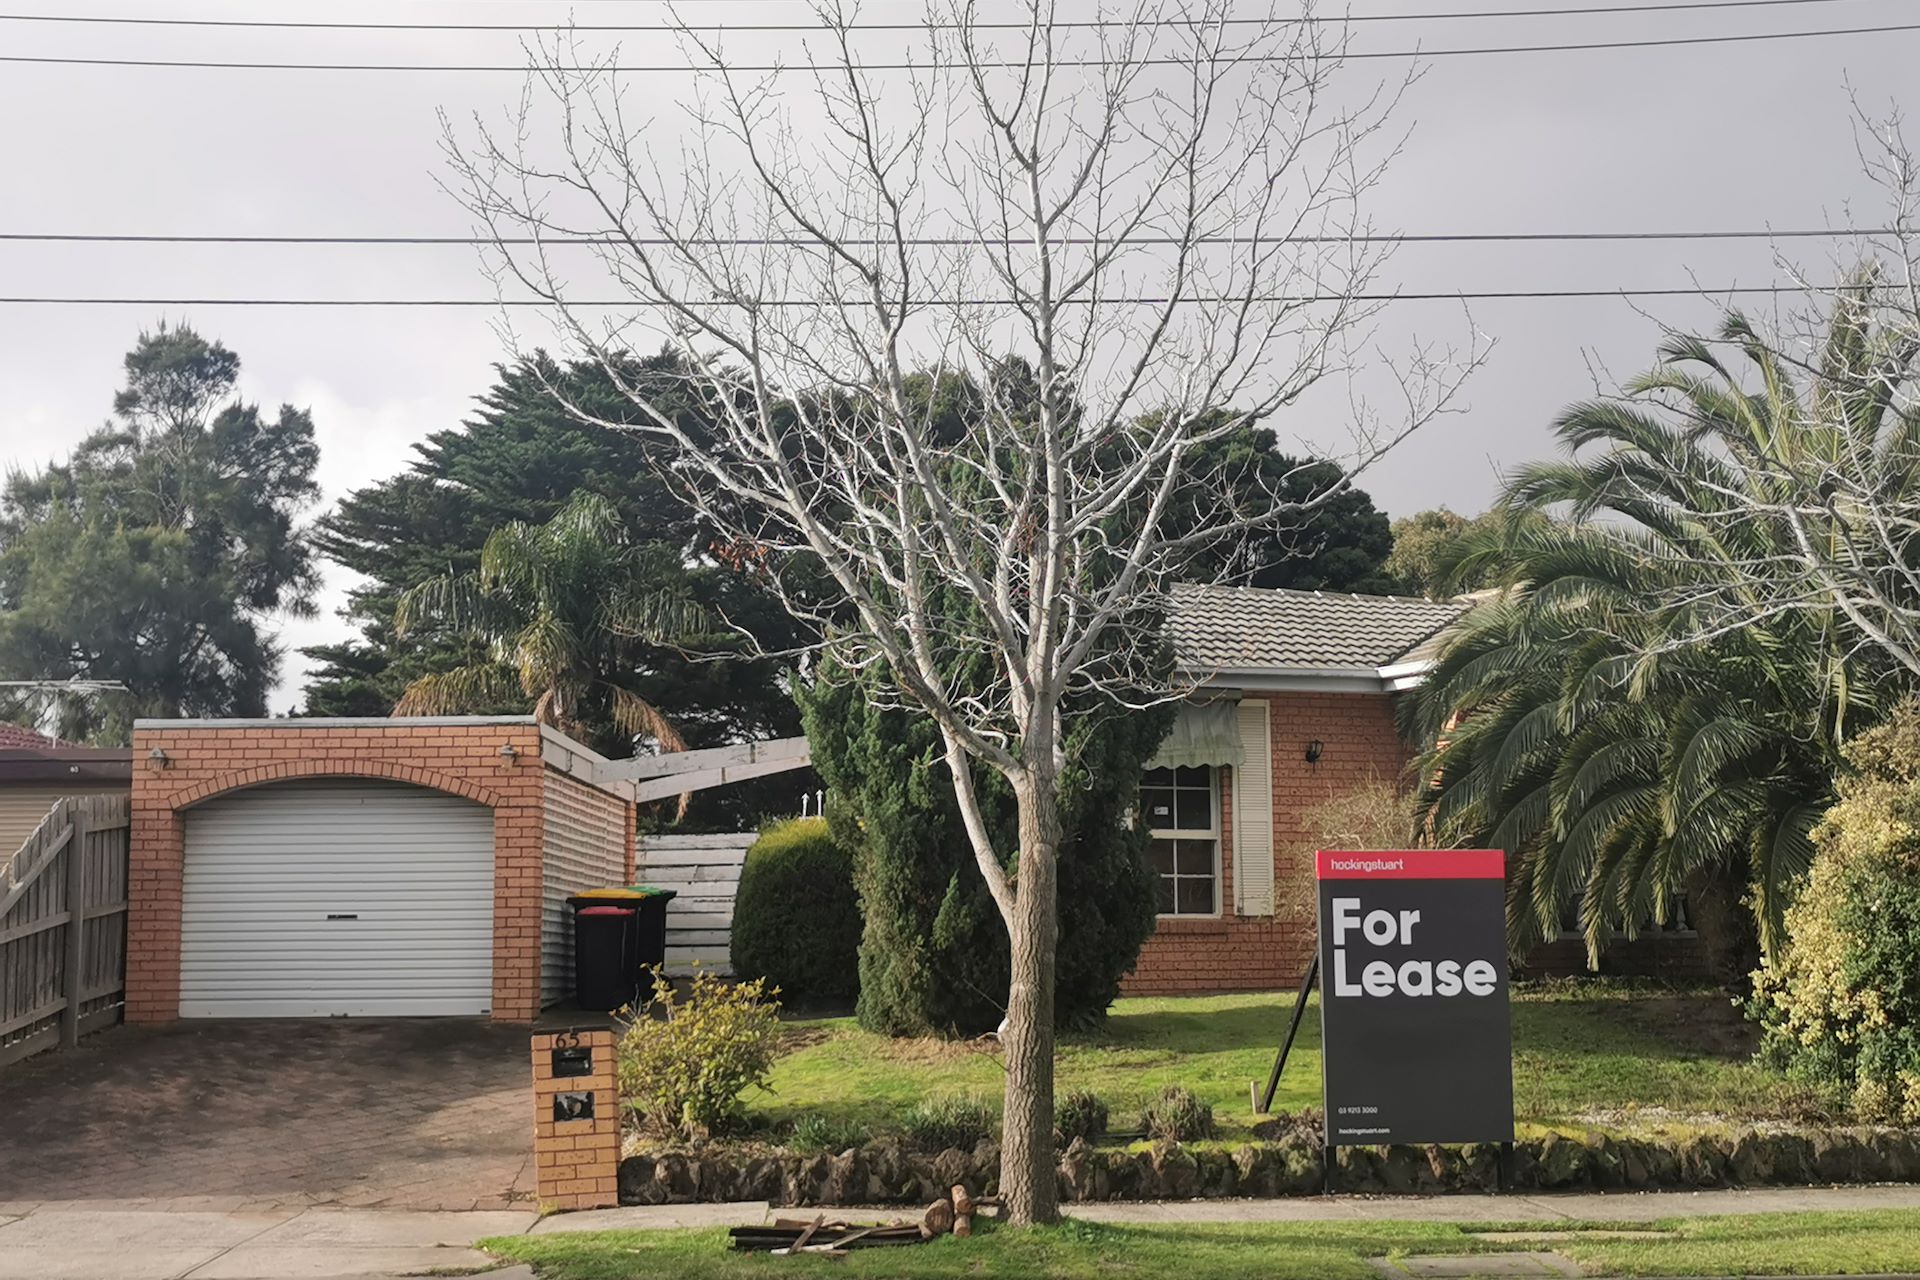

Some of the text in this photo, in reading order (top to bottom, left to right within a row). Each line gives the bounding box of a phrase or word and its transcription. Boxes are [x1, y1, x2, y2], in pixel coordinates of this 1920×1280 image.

[1330, 858, 1404, 873] hockingstuart
[1332, 897, 1421, 946] For
[1333, 948, 1498, 997] Lease
[556, 1028, 580, 1049] 65
[1338, 1106, 1347, 1114] 03
[1361, 1106, 1378, 1114] 3000
[1338, 1127, 1390, 1136] hockingstuart.com
